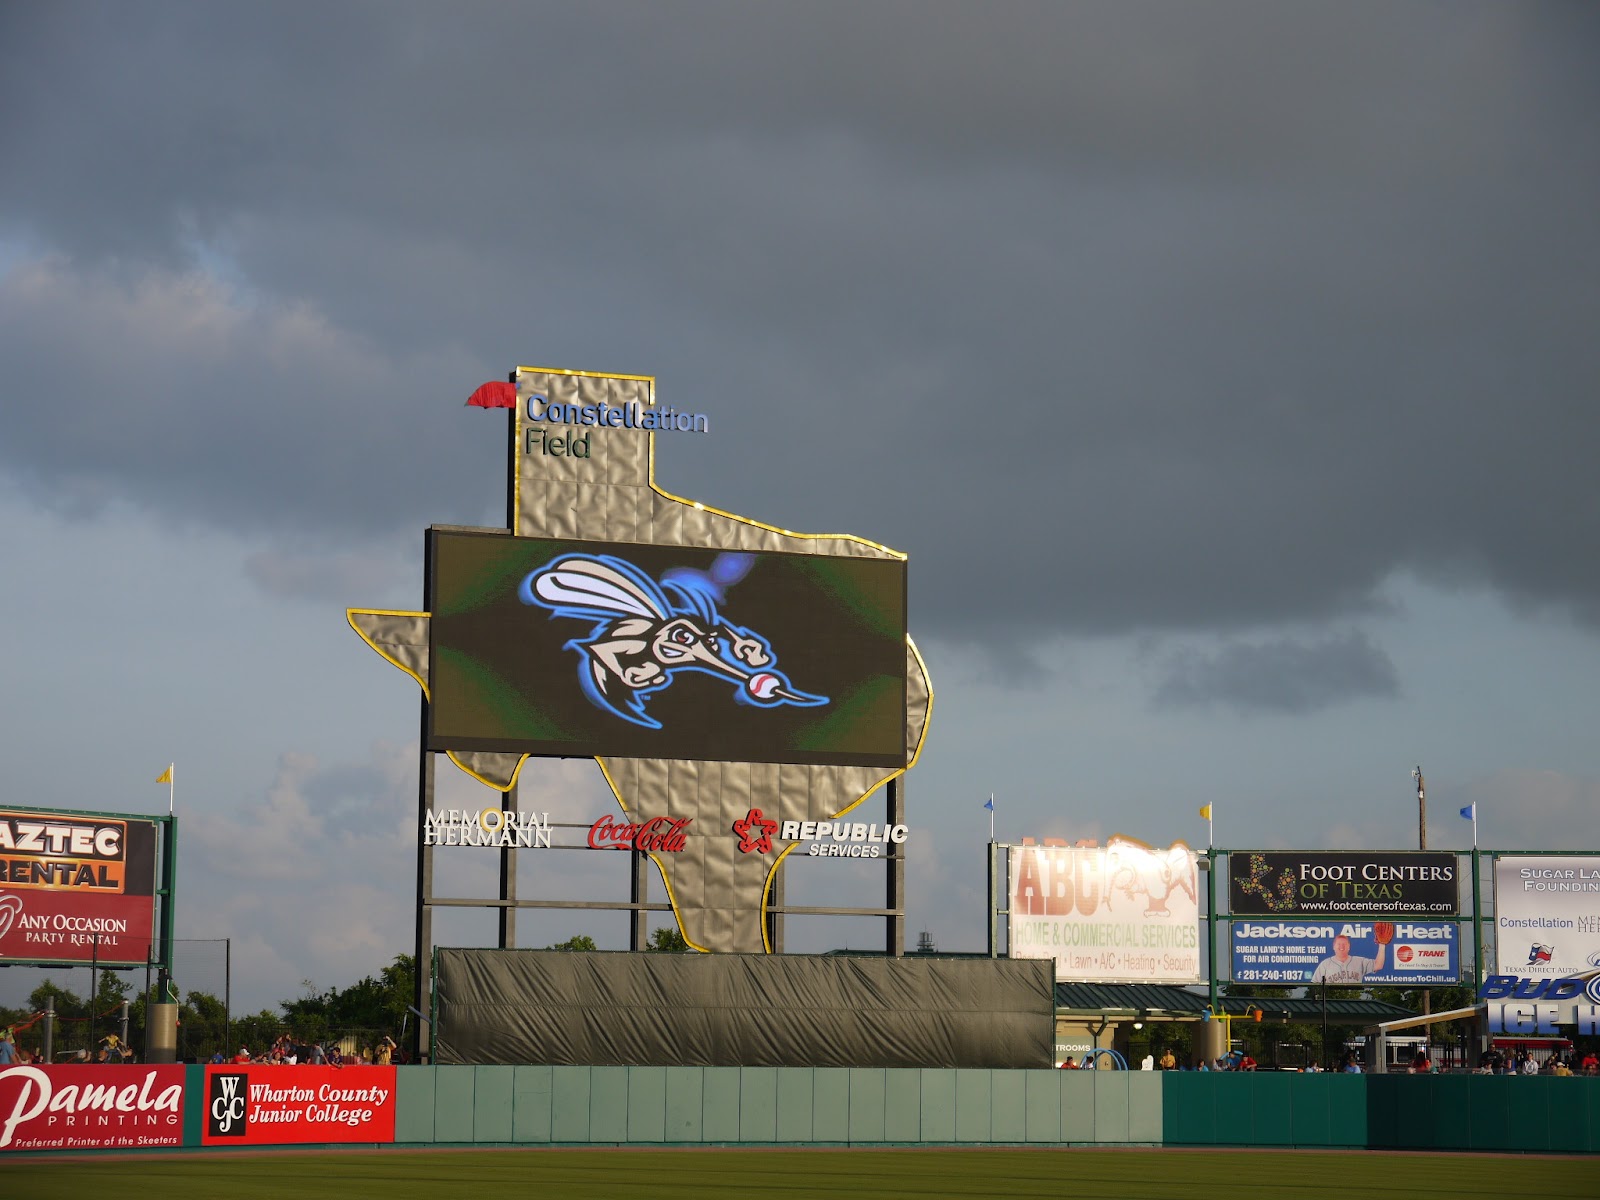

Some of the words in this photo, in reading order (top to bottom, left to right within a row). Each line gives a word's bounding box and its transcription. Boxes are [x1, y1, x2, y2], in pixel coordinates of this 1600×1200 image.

[527, 394, 709, 433] Constellation
[526, 427, 591, 459] Field
[424, 807, 553, 831] MEMORIAL
[0, 820, 122, 856] AZTEC
[424, 826, 552, 848] HERMANN
[780, 820, 909, 843] REPUBLIC
[809, 843, 880, 858] SERVICES
[1014, 837, 1099, 916] ABC
[1300, 863, 1356, 881] FOOT
[1362, 863, 1453, 881] CENTERS
[1520, 868, 1575, 879] SUGAR
[1300, 883, 1328, 899] OF
[1336, 882, 1403, 899] TEXAS
[1523, 880, 1600, 892] FOUNDIN
[1300, 901, 1452, 912] www.footcentersoftexas.com
[18, 912, 50, 929] ANY
[53, 914, 127, 932] OCCASION
[1236, 923, 1335, 938] Jackson
[1341, 924, 1372, 938] Air
[1396, 924, 1452, 938] Heat
[1500, 917, 1573, 928] Constellation
[26, 932, 65, 945] PARTY
[71, 934, 118, 946] RENTAL
[1015, 922, 1050, 945] HOME
[1052, 923, 1060, 946] &
[1063, 923, 1137, 947] COMMERCIAL
[1141, 925, 1196, 948] SERVICES
[1236, 945, 1259, 954] SUGAR
[1260, 945, 1285, 954] LAND'S
[1286, 945, 1305, 954] HOME
[1307, 945, 1326, 954] TEAM
[1243, 955, 1256, 963] FOR
[1258, 955, 1270, 963] AIR
[1271, 955, 1319, 963] CONDITIONING
[1069, 952, 1092, 969] Lawn
[1100, 952, 1115, 969] A/C
[1124, 953, 1155, 974] Heating
[1163, 953, 1196, 974] Security
[1243, 970, 1303, 980] 281-240-1037
[1480, 975, 1586, 1000] BUD
[1487, 1003, 1560, 1034] ICE
[249, 1084, 314, 1103] Wharton
[318, 1084, 388, 1106] County
[0, 1066, 182, 1147] Pamela
[249, 1104, 302, 1124] Junior
[305, 1104, 373, 1126] College
[48, 1114, 178, 1126] PRINTING
[15, 1137, 64, 1147] Preferred
[67, 1137, 100, 1146] Printer
[104, 1136, 115, 1146] of
[118, 1136, 134, 1145] the
[137, 1135, 177, 1145] Skeeters
